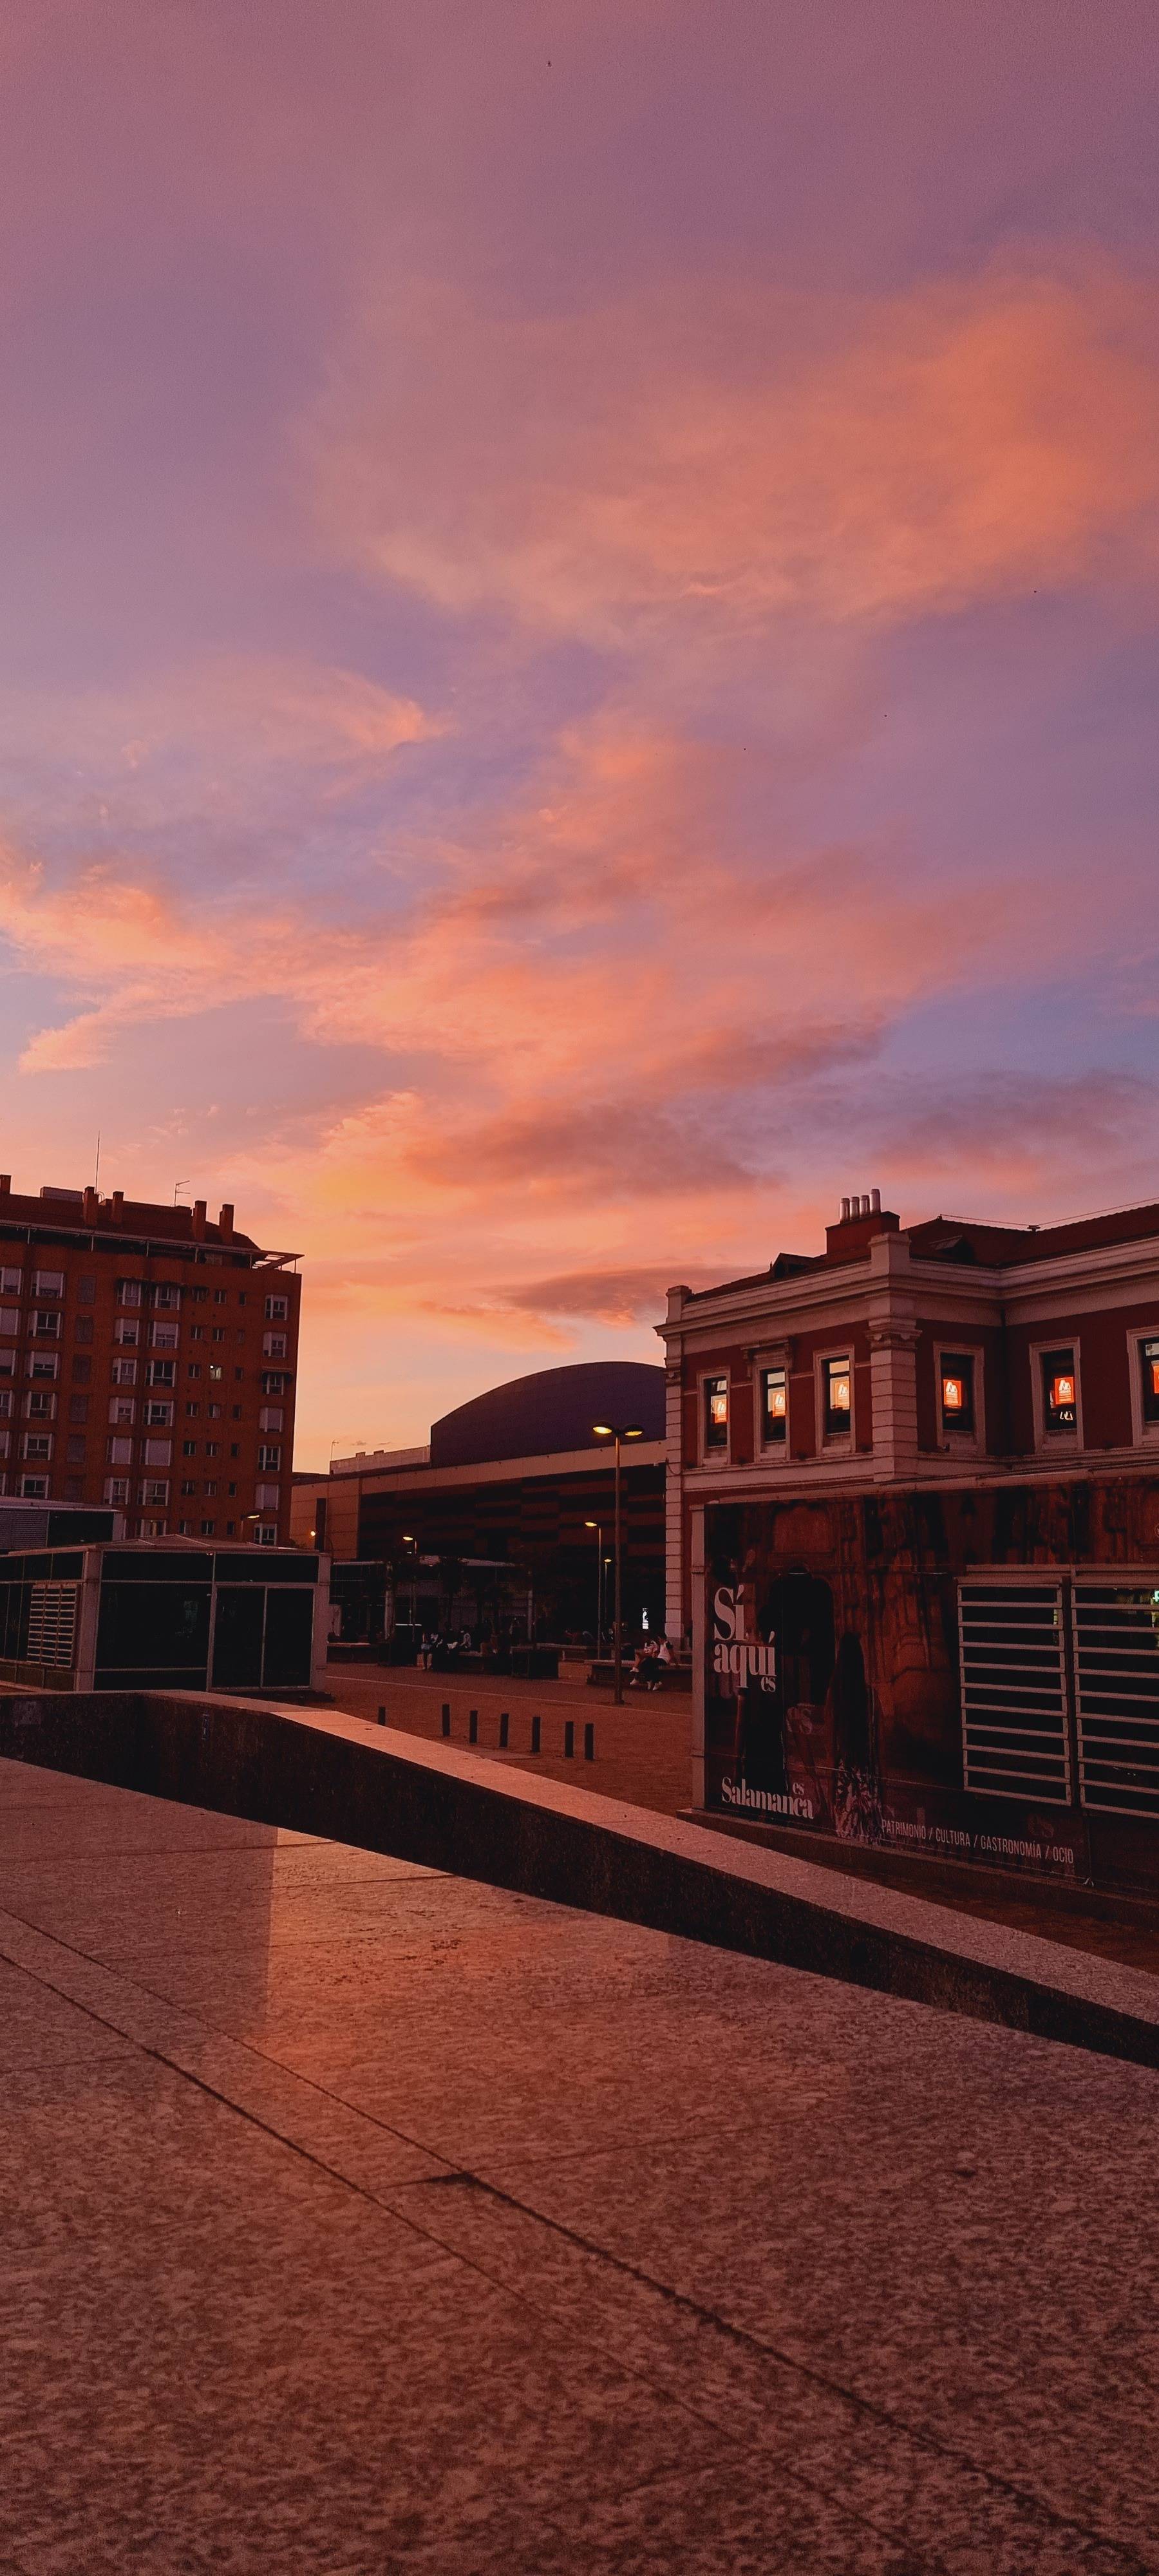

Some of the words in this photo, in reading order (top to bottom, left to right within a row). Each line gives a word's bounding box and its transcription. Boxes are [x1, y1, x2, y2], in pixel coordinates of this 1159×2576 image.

[713, 1584, 746, 1641] Sí
[713, 1631, 777, 1689] aquí
[760, 1676, 776, 1692] es
[721, 1776, 814, 1819] Salamanca
[792, 1782, 804, 1795] es
[881, 1819, 926, 1839] PATRIMONIO
[936, 1828, 970, 1847] CULTURA
[980, 1835, 1042, 1859] GASTRONOMÍA
[1053, 1846, 1074, 1864] OCIO
